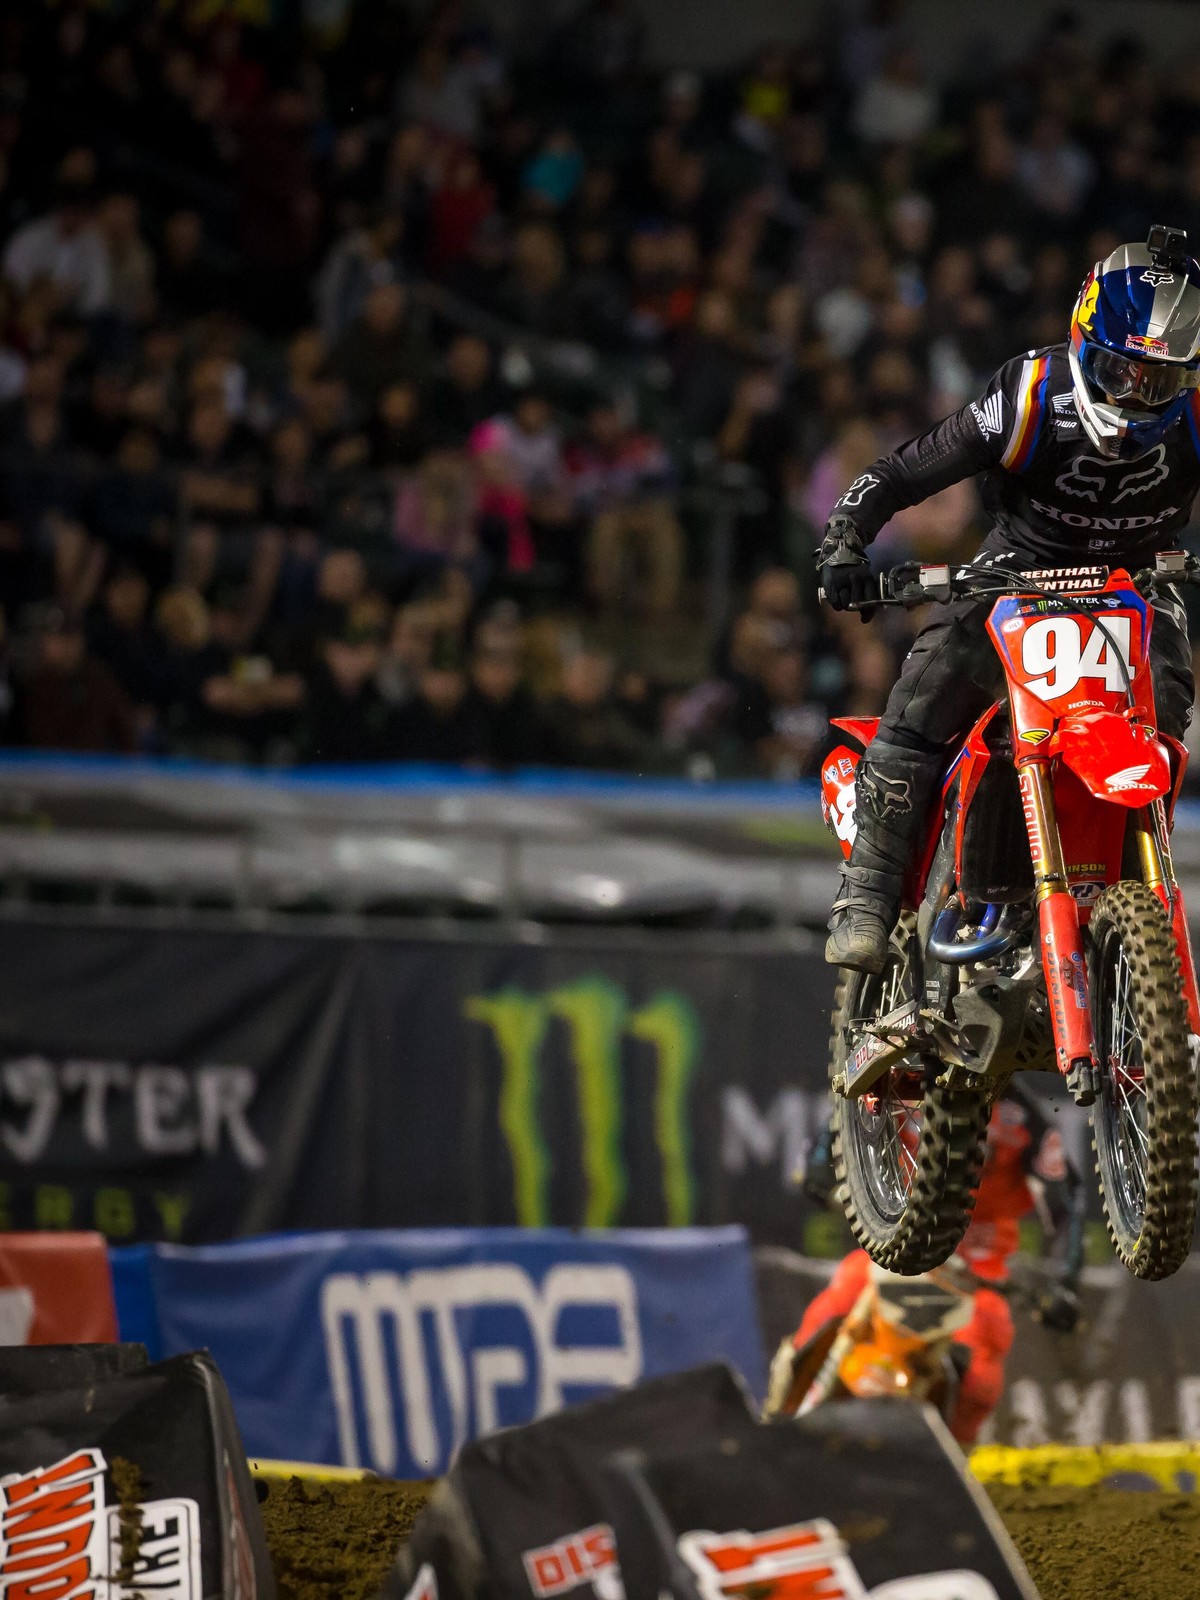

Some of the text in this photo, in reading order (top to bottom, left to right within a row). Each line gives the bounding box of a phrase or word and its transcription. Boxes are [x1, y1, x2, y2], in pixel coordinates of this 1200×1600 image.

[1126, 340, 1169, 356] Red Bull
[969, 402, 990, 442] HONDA
[1031, 499, 1181, 530] HONDA
[1020, 565, 1103, 579] RENTHAL
[1034, 578, 1105, 591] ENTHAL
[1022, 616, 1136, 701] 94
[1067, 699, 1105, 711] HONDA
[1107, 782, 1159, 794] HONDA
[1065, 863, 1106, 872] INSON
[0, 1453, 96, 1600] OUNT
[112, 1515, 182, 1600] IRE
